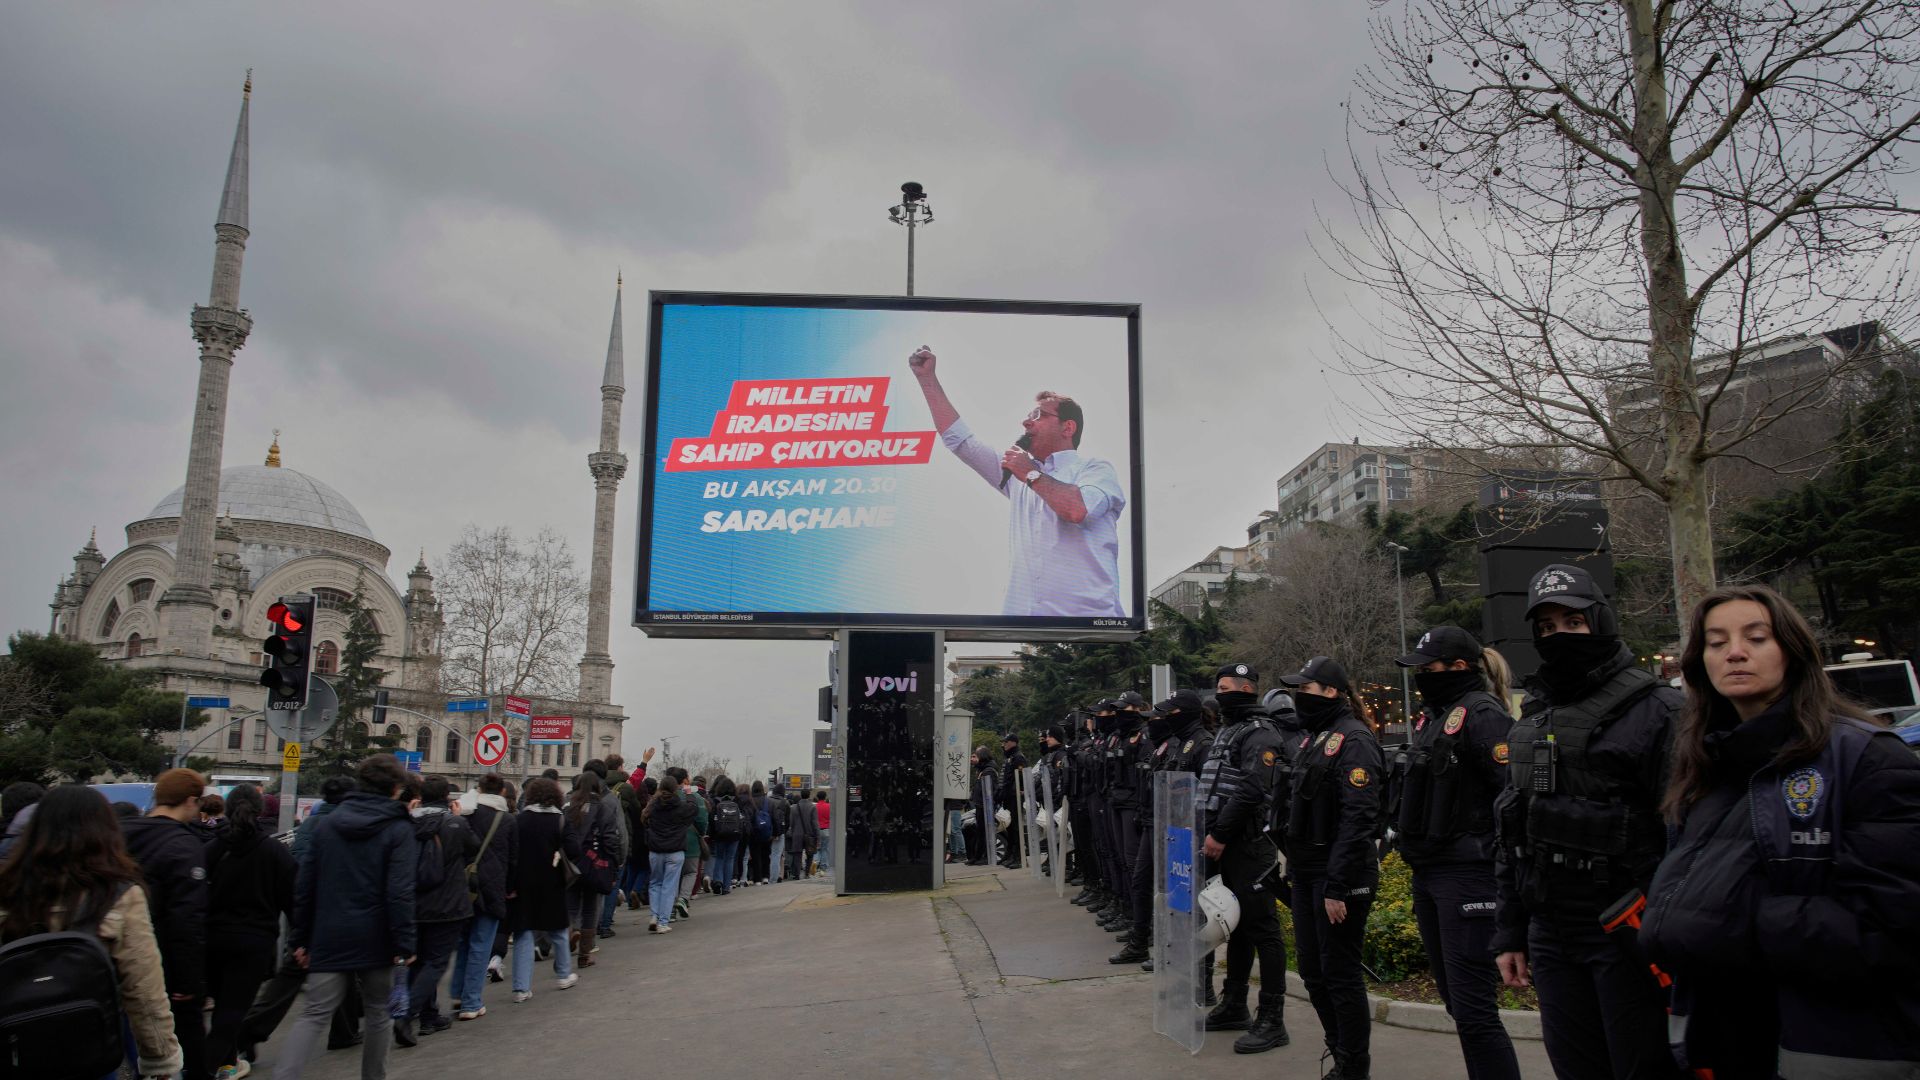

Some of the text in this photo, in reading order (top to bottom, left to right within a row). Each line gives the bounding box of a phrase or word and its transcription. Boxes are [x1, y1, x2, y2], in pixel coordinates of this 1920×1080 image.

[746, 384, 874, 407] MİLLETİN
[726, 411, 875, 434] İRADESİNE
[679, 438, 921, 464] SAHİP ÇIKIYORUZ
[703, 476, 897, 500] BU AKŞAM 20.30
[700, 506, 897, 535] SARAÇHANE
[653, 612, 682, 620] İSTANBUL
[719, 613, 754, 621] BELEDİYESİ
[1093, 618, 1117, 626] KÜLTÜR
[864, 670, 918, 697] yovi
[273, 701, 300, 710] 07-012
[532, 719, 572, 727] DOLMABAHÇE
[1790, 827, 1832, 845] OLİS
